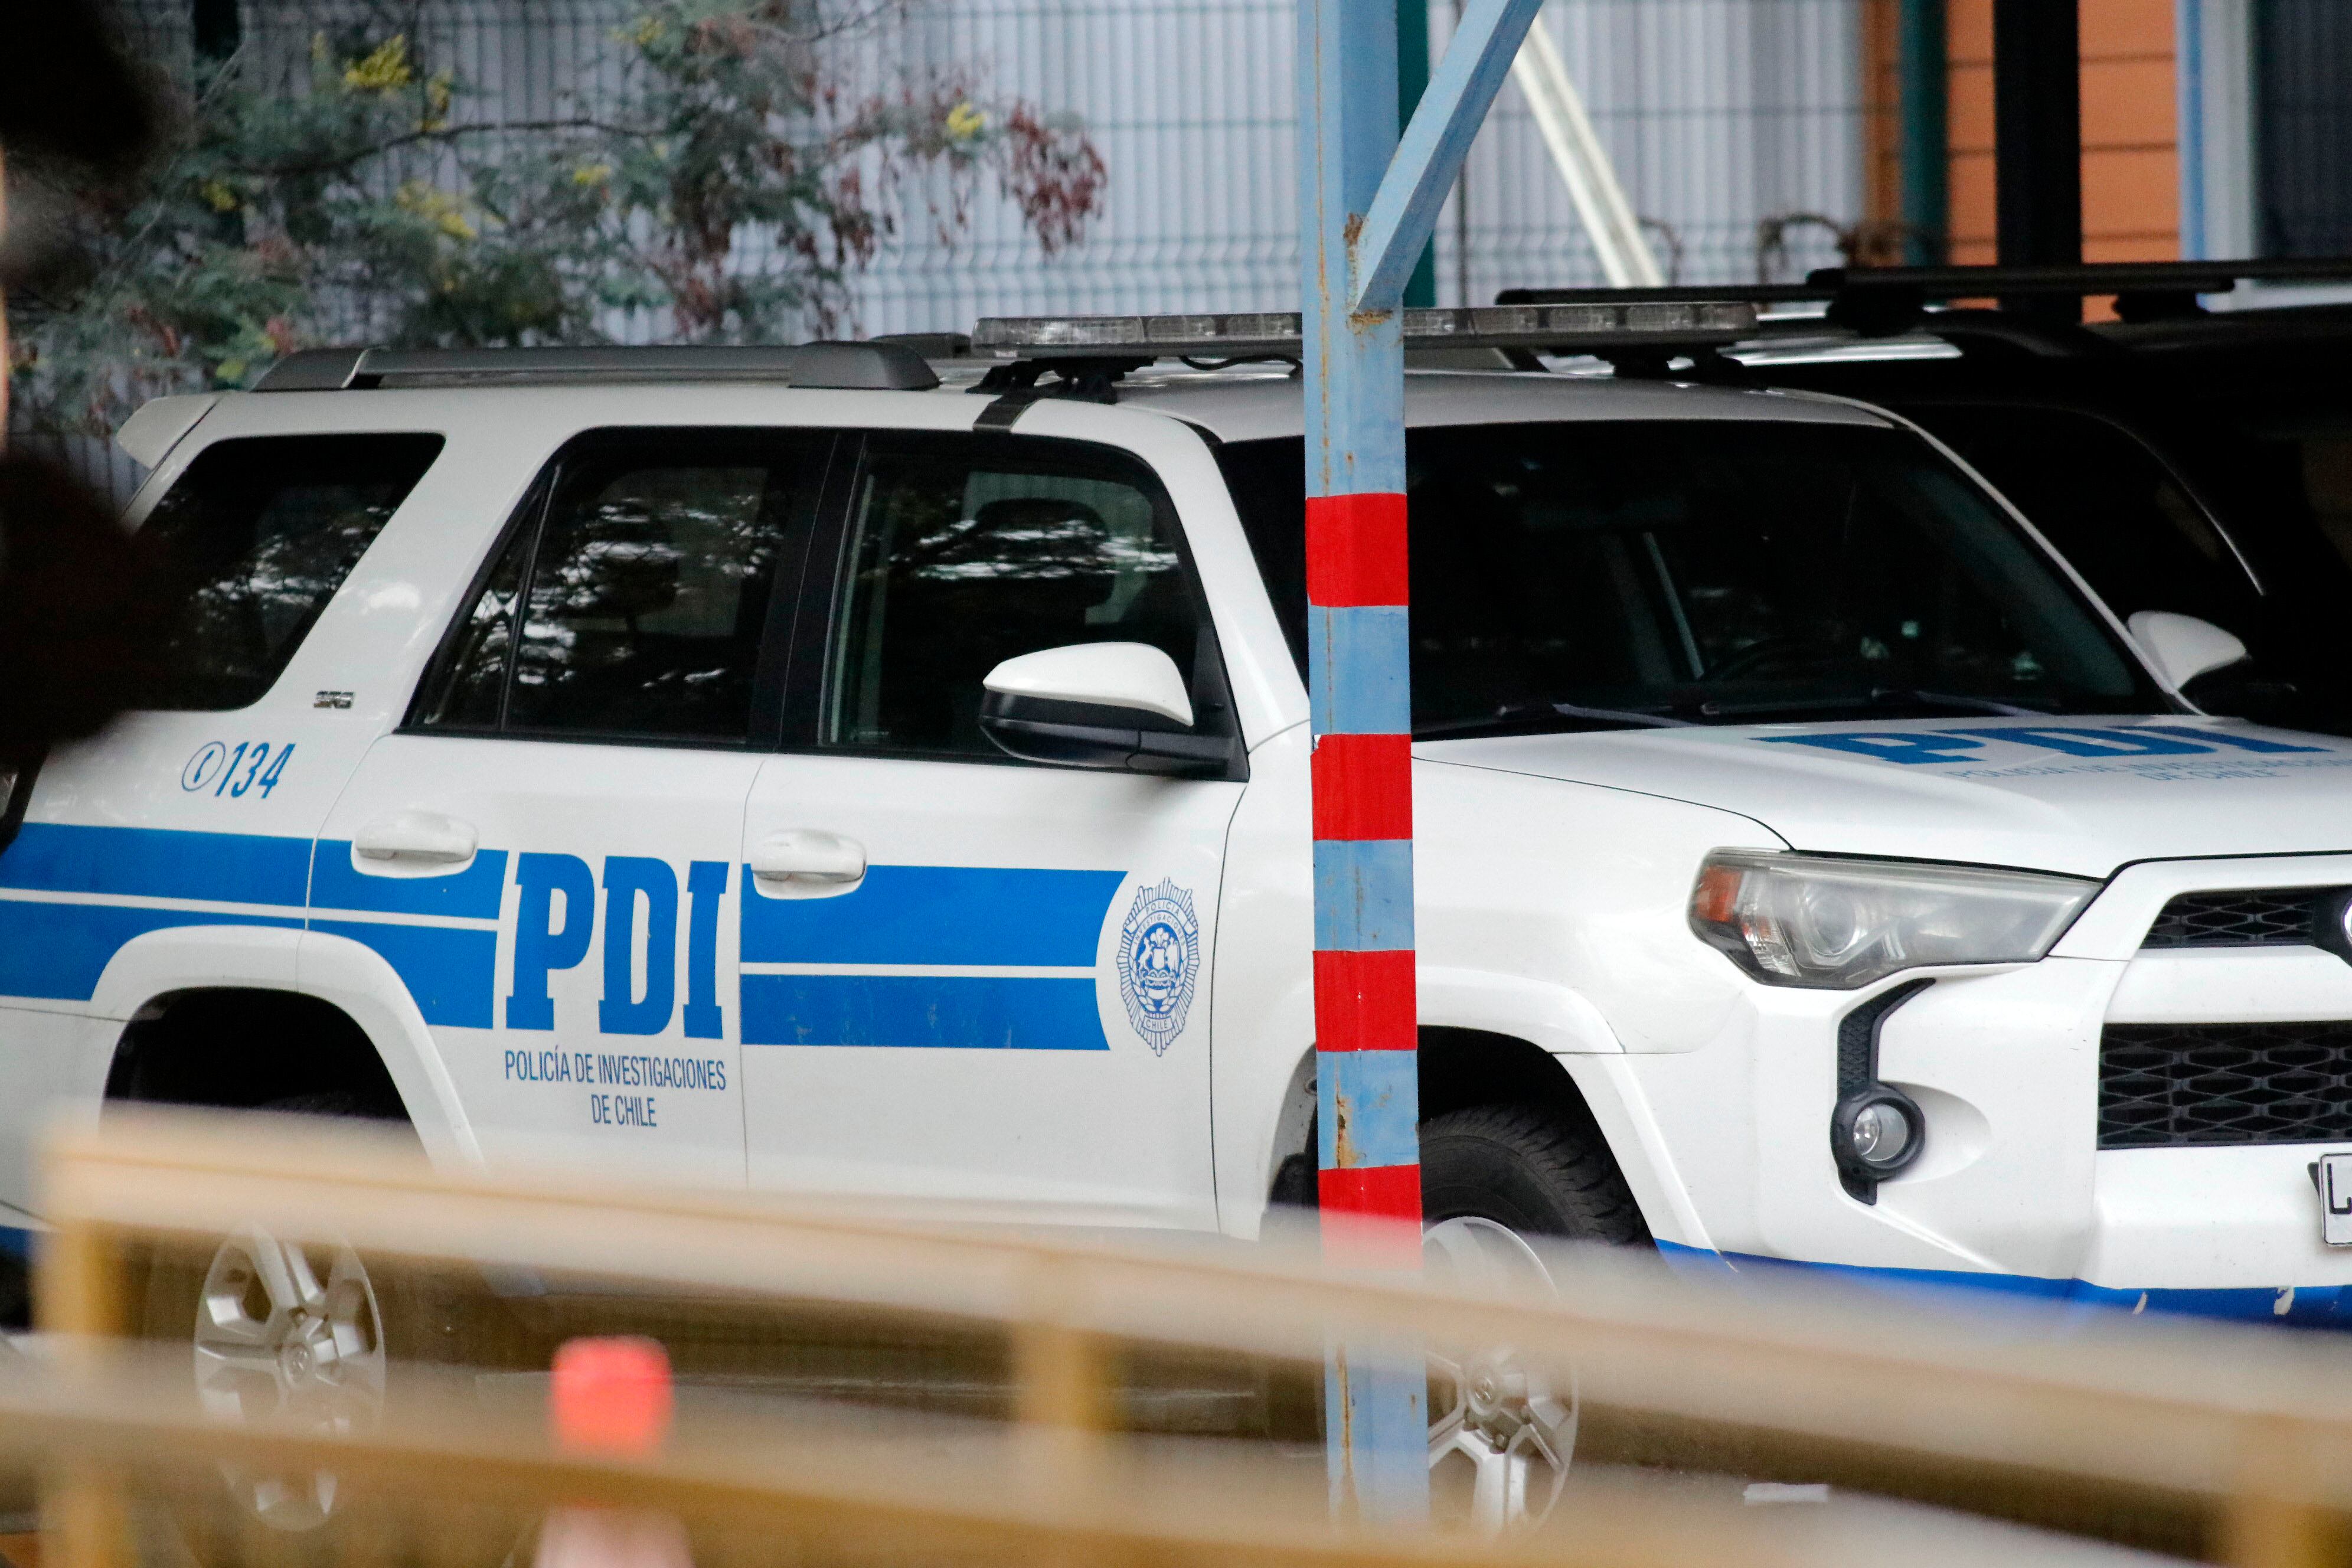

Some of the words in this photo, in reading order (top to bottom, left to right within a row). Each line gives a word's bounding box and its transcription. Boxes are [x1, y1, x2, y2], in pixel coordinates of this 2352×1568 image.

[1749, 726, 2335, 765] PDI
[214, 741, 296, 799] 134
[506, 852, 729, 1039] PDI
[1145, 1019, 1168, 1030] CHILE
[505, 1045, 571, 1082] POLICÍA
[574, 1053, 594, 1083] DE
[597, 1054, 727, 1090] INVESTIGACIONES
[591, 1094, 612, 1125] DE
[615, 1096, 658, 1127] CHILE
